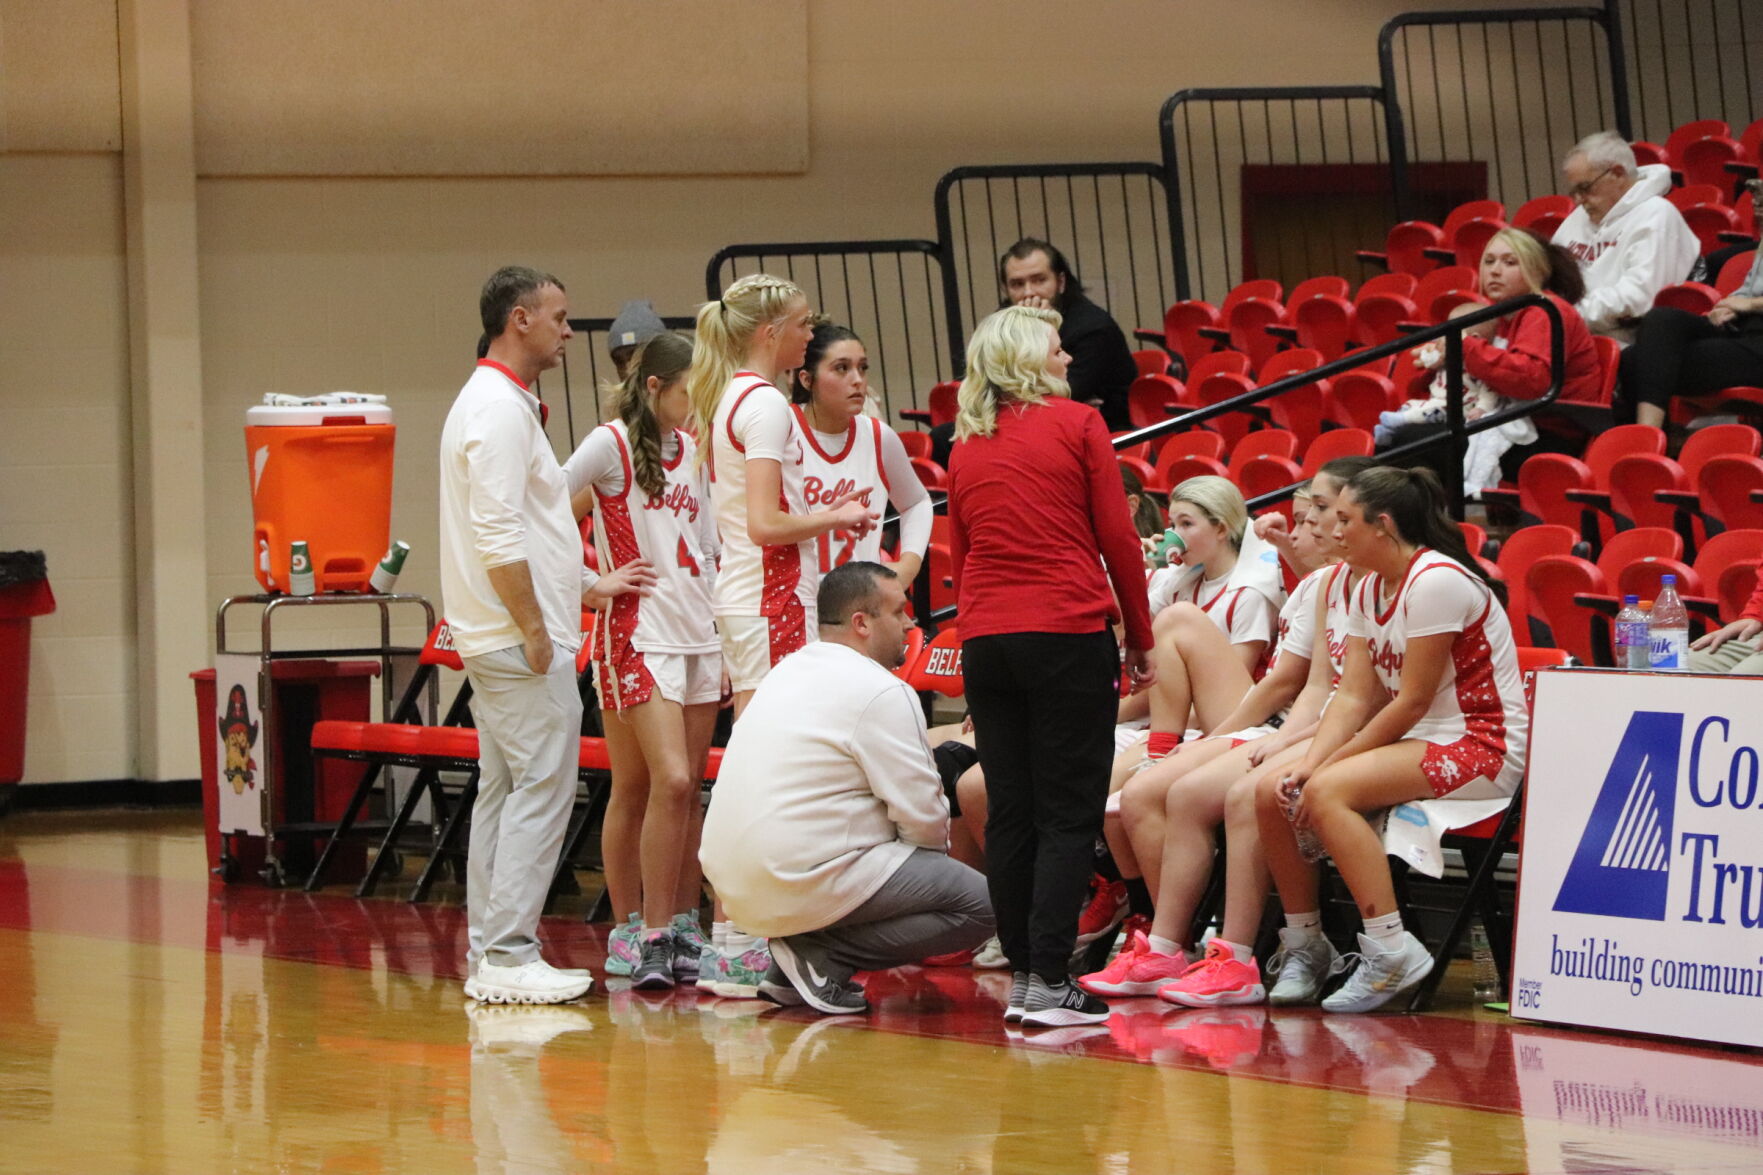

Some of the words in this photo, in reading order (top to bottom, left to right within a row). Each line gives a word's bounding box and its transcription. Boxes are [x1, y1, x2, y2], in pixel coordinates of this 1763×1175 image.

[677, 531, 701, 577] 4
[1689, 715, 1763, 810] Co
[1680, 832, 1763, 929] Tru
[1519, 978, 1542, 989] Member
[1551, 934, 1644, 996] building
[1651, 955, 1763, 998] communi
[1518, 989, 1541, 1009] FDIC
